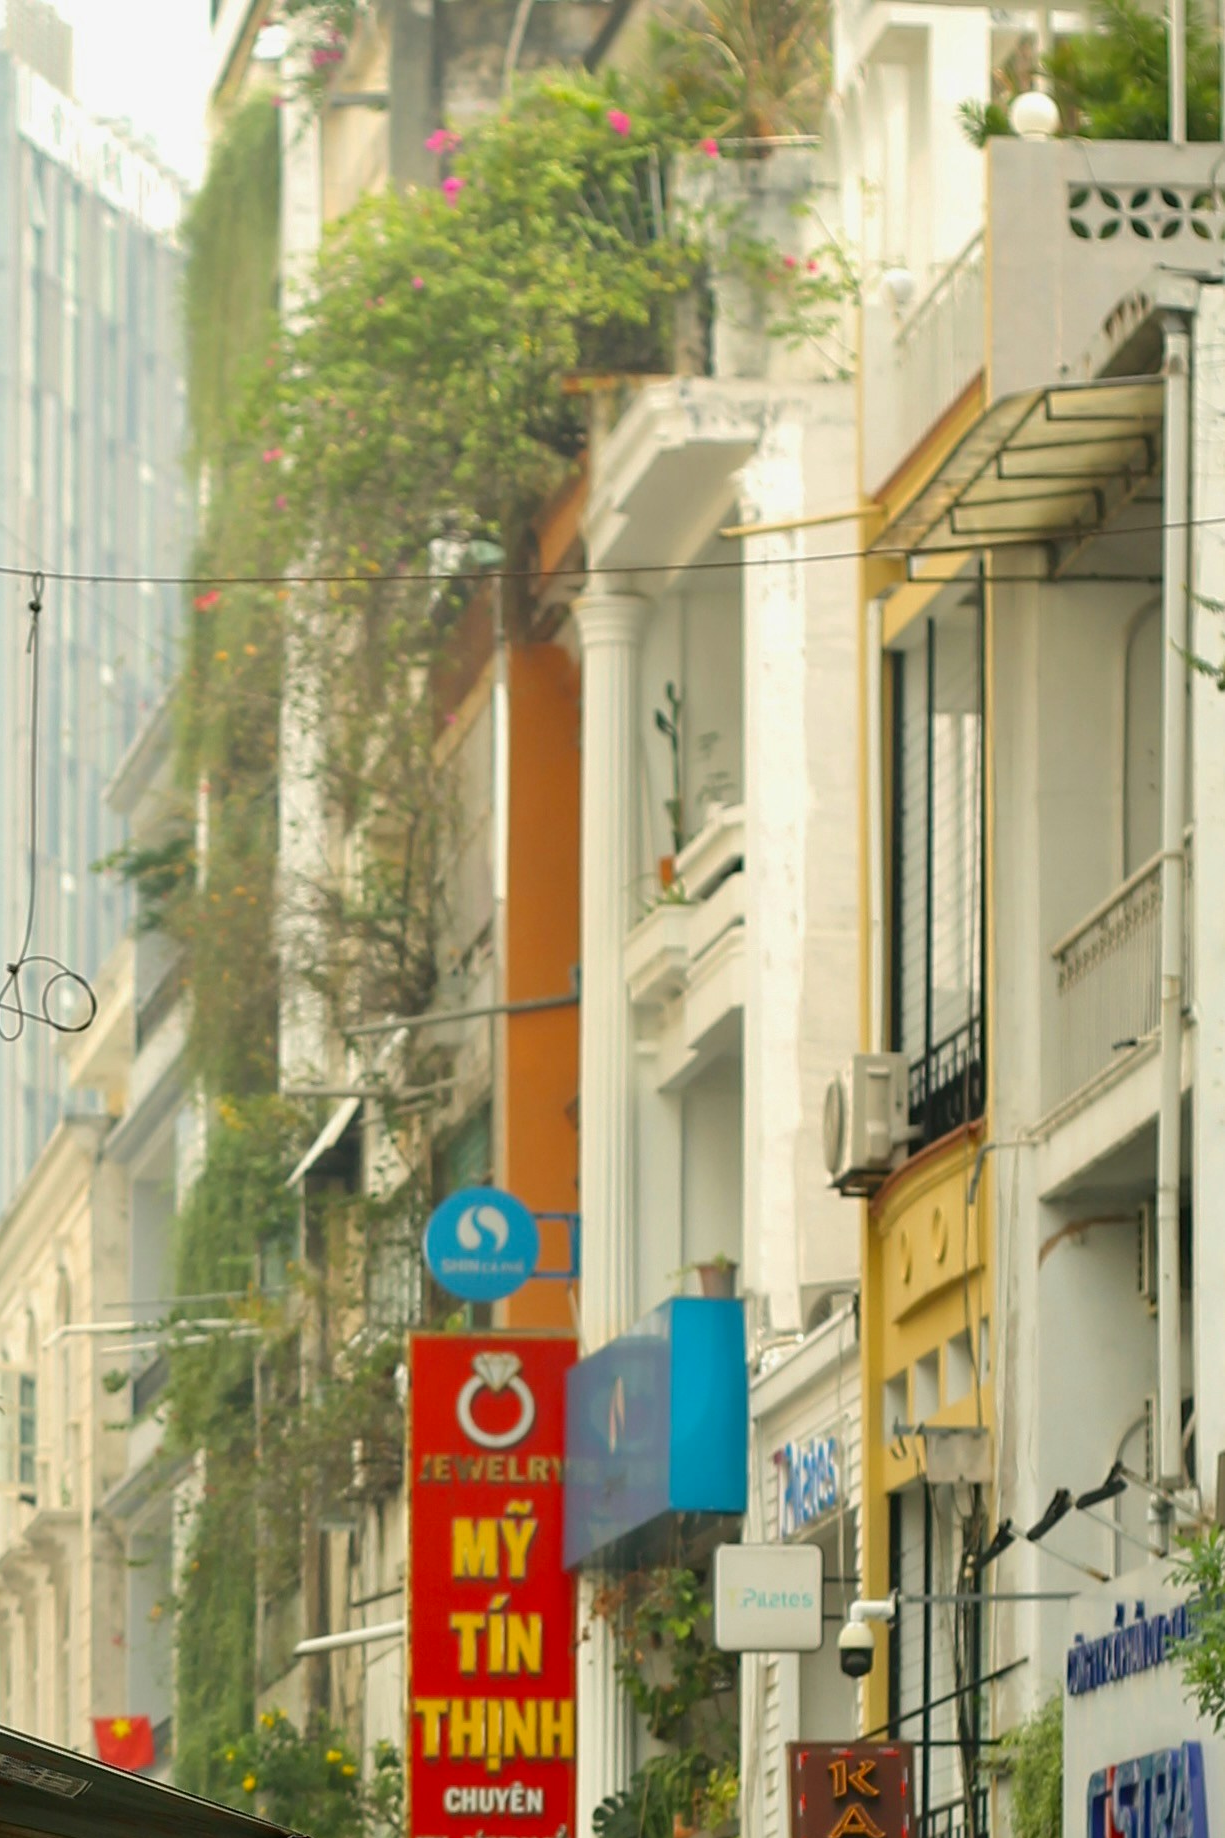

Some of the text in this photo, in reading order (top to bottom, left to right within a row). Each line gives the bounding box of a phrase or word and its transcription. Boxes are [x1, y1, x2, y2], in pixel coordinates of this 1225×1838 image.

[452, 1500, 537, 1579] MỸ
[451, 1594, 542, 1676] TÍN
[415, 1698, 574, 1775] THỊNH
[444, 1782, 543, 1815] CHUYÊN
